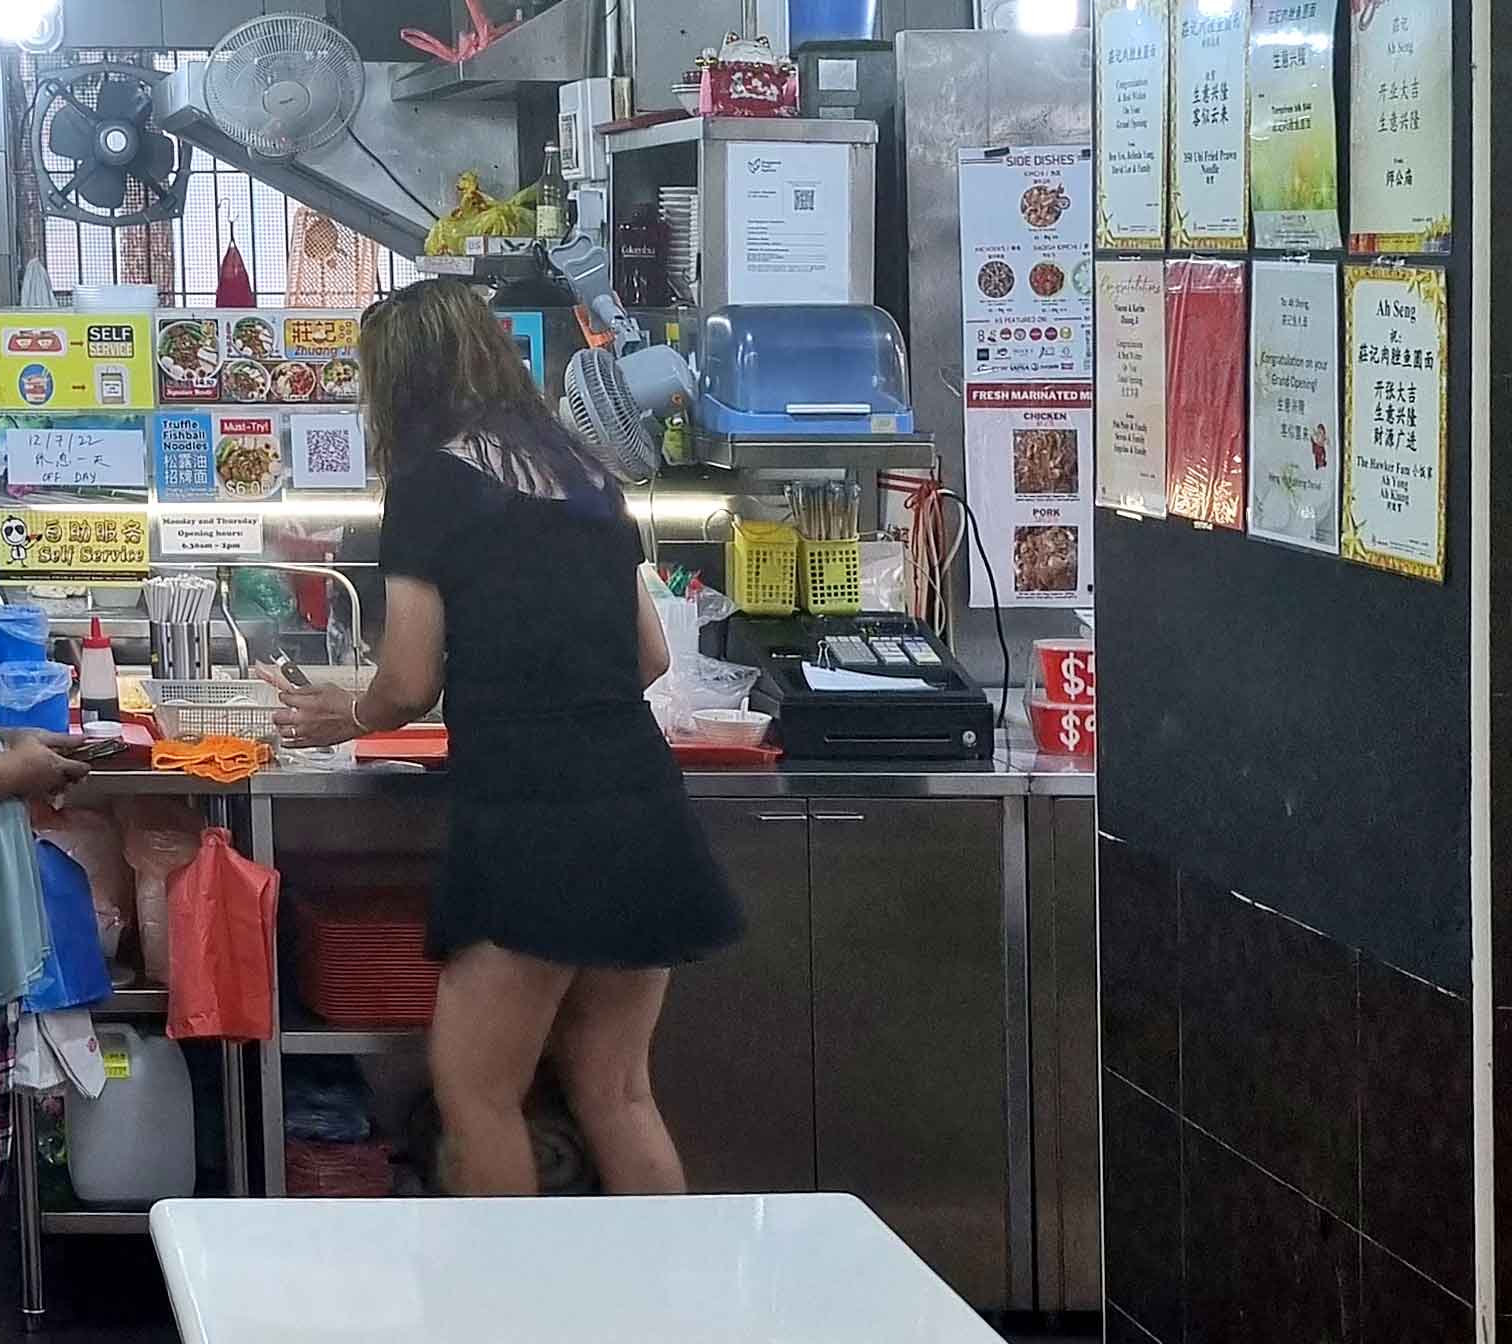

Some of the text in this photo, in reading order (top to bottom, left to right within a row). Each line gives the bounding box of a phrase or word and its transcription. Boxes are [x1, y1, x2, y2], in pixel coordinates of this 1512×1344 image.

[1377, 109, 1420, 132] 生意兴隆
[1006, 154, 1075, 167] SIDE DISHES
[1376, 300, 1416, 323] Ah Seng
[89, 327, 131, 341] SELF
[90, 342, 133, 356] SERVICE
[972, 390, 1009, 401] FRESH
[1011, 390, 1078, 401] MARINATED
[1374, 380, 1417, 403] 开张大吉
[1023, 412, 1067, 421] CHICKEN
[1374, 403, 1417, 428] 生意兴隆
[162, 419, 199, 430] Truffle
[223, 421, 269, 432] Must-Try!
[163, 430, 206, 440] Fishball
[163, 441, 208, 451] Noodles
[1032, 508, 1061, 518] PORK
[44, 519, 145, 545] 自助服务
[178, 529, 214, 537] Opening
[38, 544, 145, 567] Self Service
